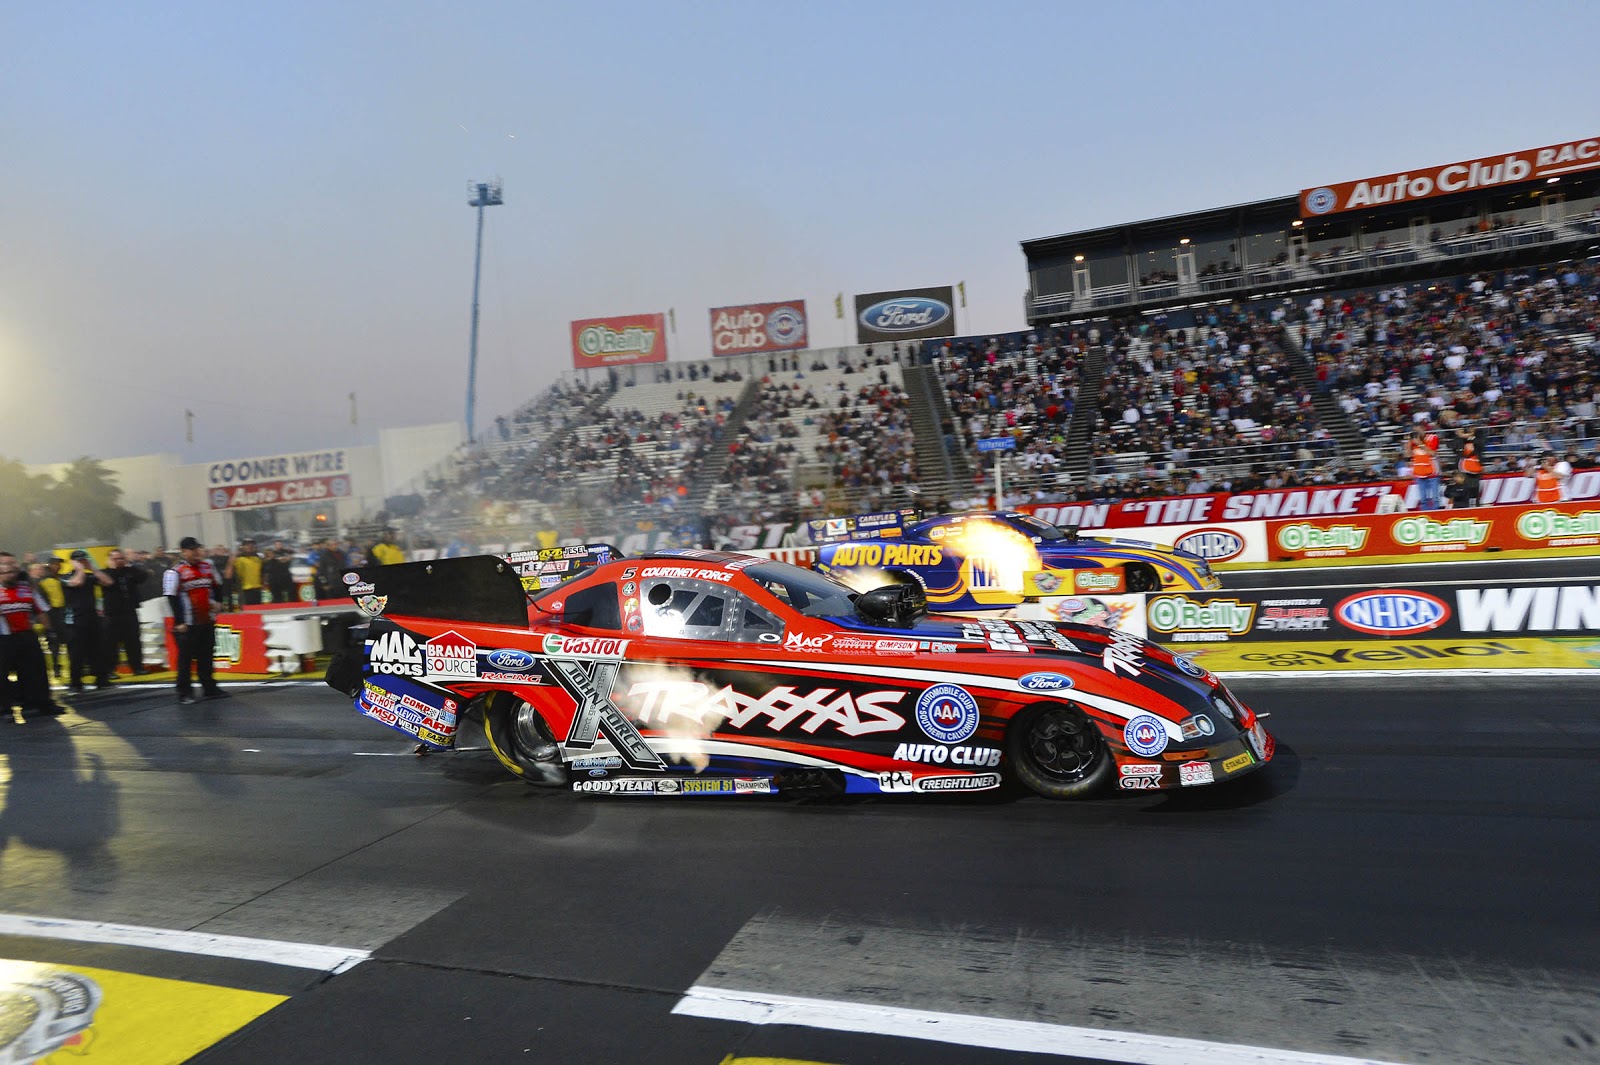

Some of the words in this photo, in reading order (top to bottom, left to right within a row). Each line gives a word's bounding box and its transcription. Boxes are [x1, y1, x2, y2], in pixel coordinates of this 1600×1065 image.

[1346, 174, 1434, 209] Auto
[1437, 155, 1532, 192] Club
[1536, 141, 1600, 168] RAC
[713, 309, 765, 331] Auto
[876, 303, 933, 327] Ford
[715, 329, 767, 350] Club
[209, 458, 289, 484] COONER
[293, 451, 345, 474] WIRE
[230, 487, 278, 506] Auto
[280, 480, 328, 501] Club
[1281, 525, 1367, 549] O'Reilly
[1395, 518, 1488, 545] O'Reilly
[564, 546, 586, 555] JESEL
[1182, 534, 1239, 557] NHRA
[831, 545, 882, 566] AUTO
[882, 545, 944, 566] PARTS
[621, 567, 638, 580] 5
[641, 567, 697, 578] COURTNEY
[696, 569, 734, 582] FORCE
[1154, 599, 1249, 629] O'Reilly
[1265, 607, 1329, 619] SUPER
[1353, 597, 1436, 627] NHRA
[1456, 585, 1600, 632] WIN
[1257, 617, 1331, 630] START
[370, 631, 423, 663] MAC
[427, 644, 475, 659] BRAND
[563, 638, 622, 655] Castrol
[878, 641, 914, 649] SIMPSON
[427, 659, 476, 674] SOURCE
[497, 652, 525, 667] Ford
[371, 662, 424, 676] TOOLS
[481, 672, 542, 684] RACING
[1028, 675, 1063, 688] Ford
[565, 668, 604, 706] JOHN
[403, 696, 431, 713] COMP
[922, 686, 959, 708] AUTOMOBILE
[959, 692, 974, 710] CLUB
[371, 706, 397, 722] MSD
[628, 681, 908, 737] TRAXXAS
[934, 704, 961, 720] AAA
[398, 718, 420, 733] WELD
[421, 717, 457, 734] ARP
[599, 704, 645, 754] FORCE
[919, 710, 946, 740] SOUTHERN
[947, 713, 976, 740] CALIFORNIA
[893, 743, 948, 764] AUTO
[950, 745, 1002, 767] CLUB
[1226, 755, 1249, 769] STANLEY
[1131, 765, 1159, 774] Castrol
[1181, 764, 1212, 774] BRAND
[1181, 772, 1214, 783] SOURCE
[573, 779, 653, 793] GOODYEAR
[684, 780, 721, 792] SYSTEM
[722, 780, 733, 791] 51
[736, 781, 769, 790] CHAMPION
[880, 771, 912, 789] PPG
[921, 776, 995, 790] FREIGHTLINER
[1119, 774, 1163, 789] GTX
